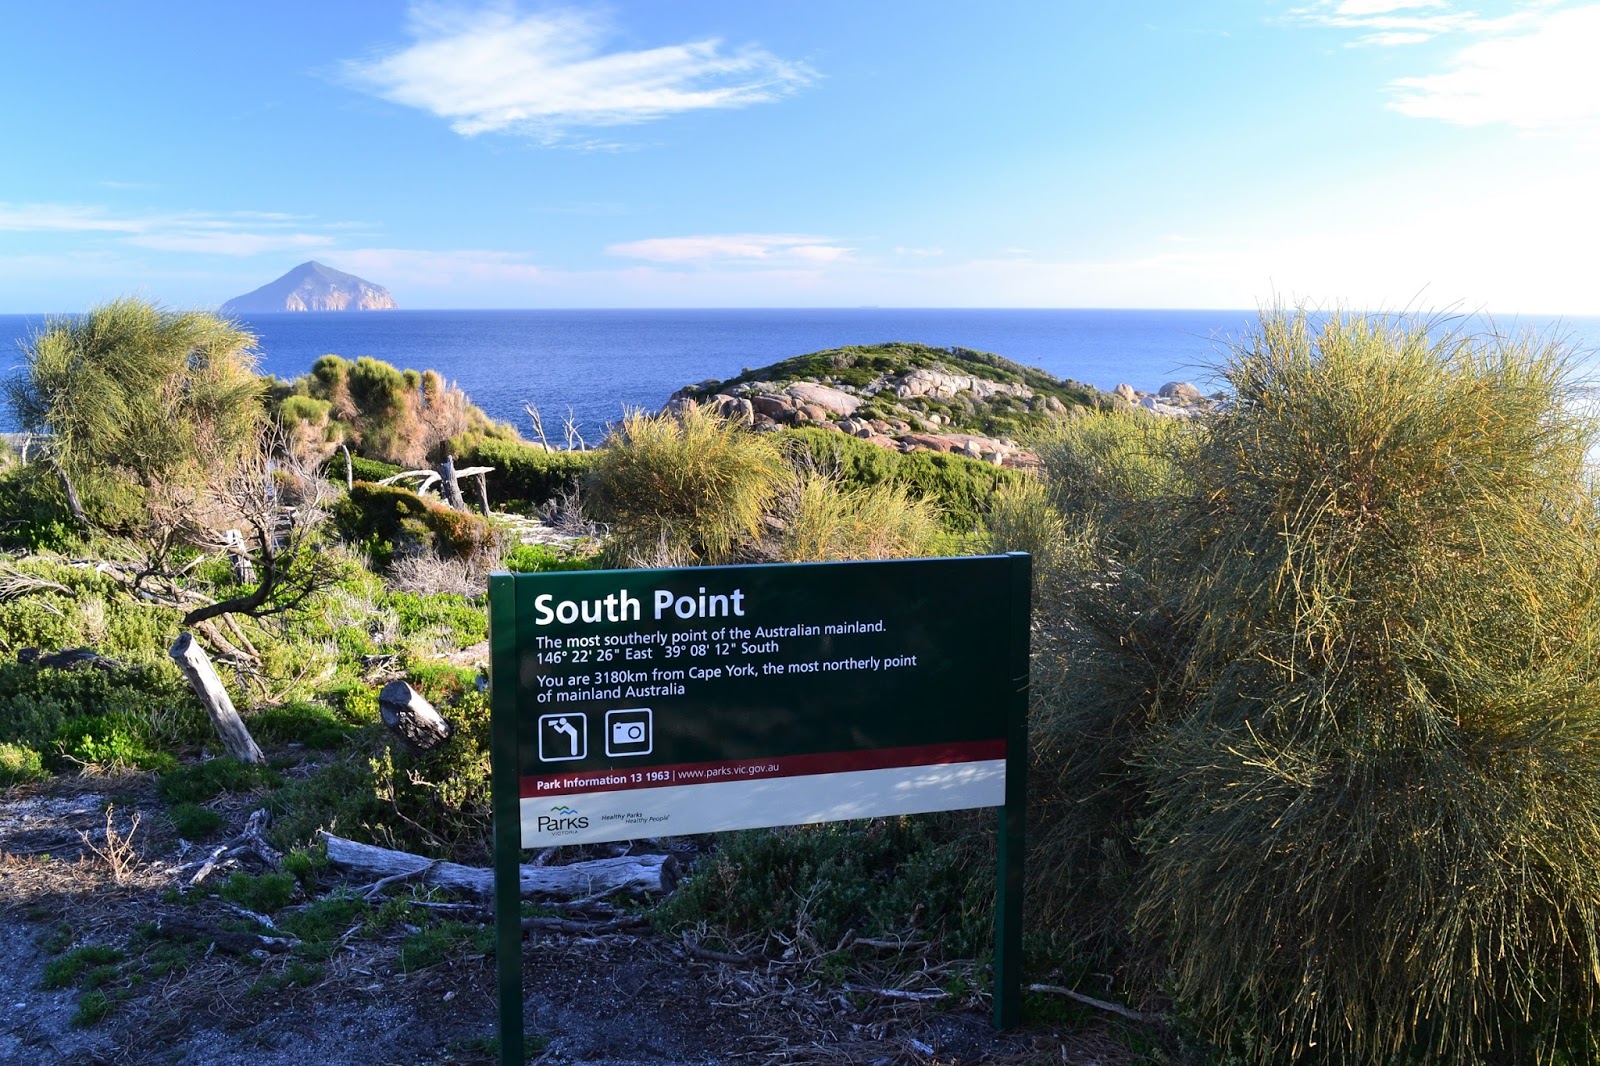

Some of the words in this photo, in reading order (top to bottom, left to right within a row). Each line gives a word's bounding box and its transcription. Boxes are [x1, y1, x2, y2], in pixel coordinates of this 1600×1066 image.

[534, 589, 641, 626] South
[654, 587, 745, 620] Point
[536, 636, 562, 649] The
[566, 635, 600, 648] most
[604, 631, 667, 647] southerly
[671, 629, 707, 645] point
[711, 627, 725, 641] of
[729, 627, 751, 640] the
[755, 624, 820, 639] Australian
[824, 619, 886, 635] mainland.
[537, 651, 567, 665] 146°
[625, 647, 653, 660] East
[665, 645, 686, 658] 39°
[741, 640, 779, 654] South
[537, 675, 564, 688] You
[567, 675, 590, 685] are
[594, 670, 648, 685] 3180km
[652, 668, 684, 681] from
[688, 666, 722, 681] Cape
[726, 663, 758, 678] York,
[762, 662, 784, 675] the
[788, 661, 819, 673] most
[823, 656, 880, 672] northerly
[884, 654, 917, 670] point
[537, 690, 552, 703] of
[556, 686, 621, 702] mainland
[625, 683, 685, 698] Australia
[537, 778, 561, 790] Park
[563, 775, 627, 788] Information
[630, 773, 642, 783] 13
[646, 770, 670, 782] 1963
[677, 763, 780, 780] www.parks.vic.gov.au
[537, 815, 589, 832] Parks
